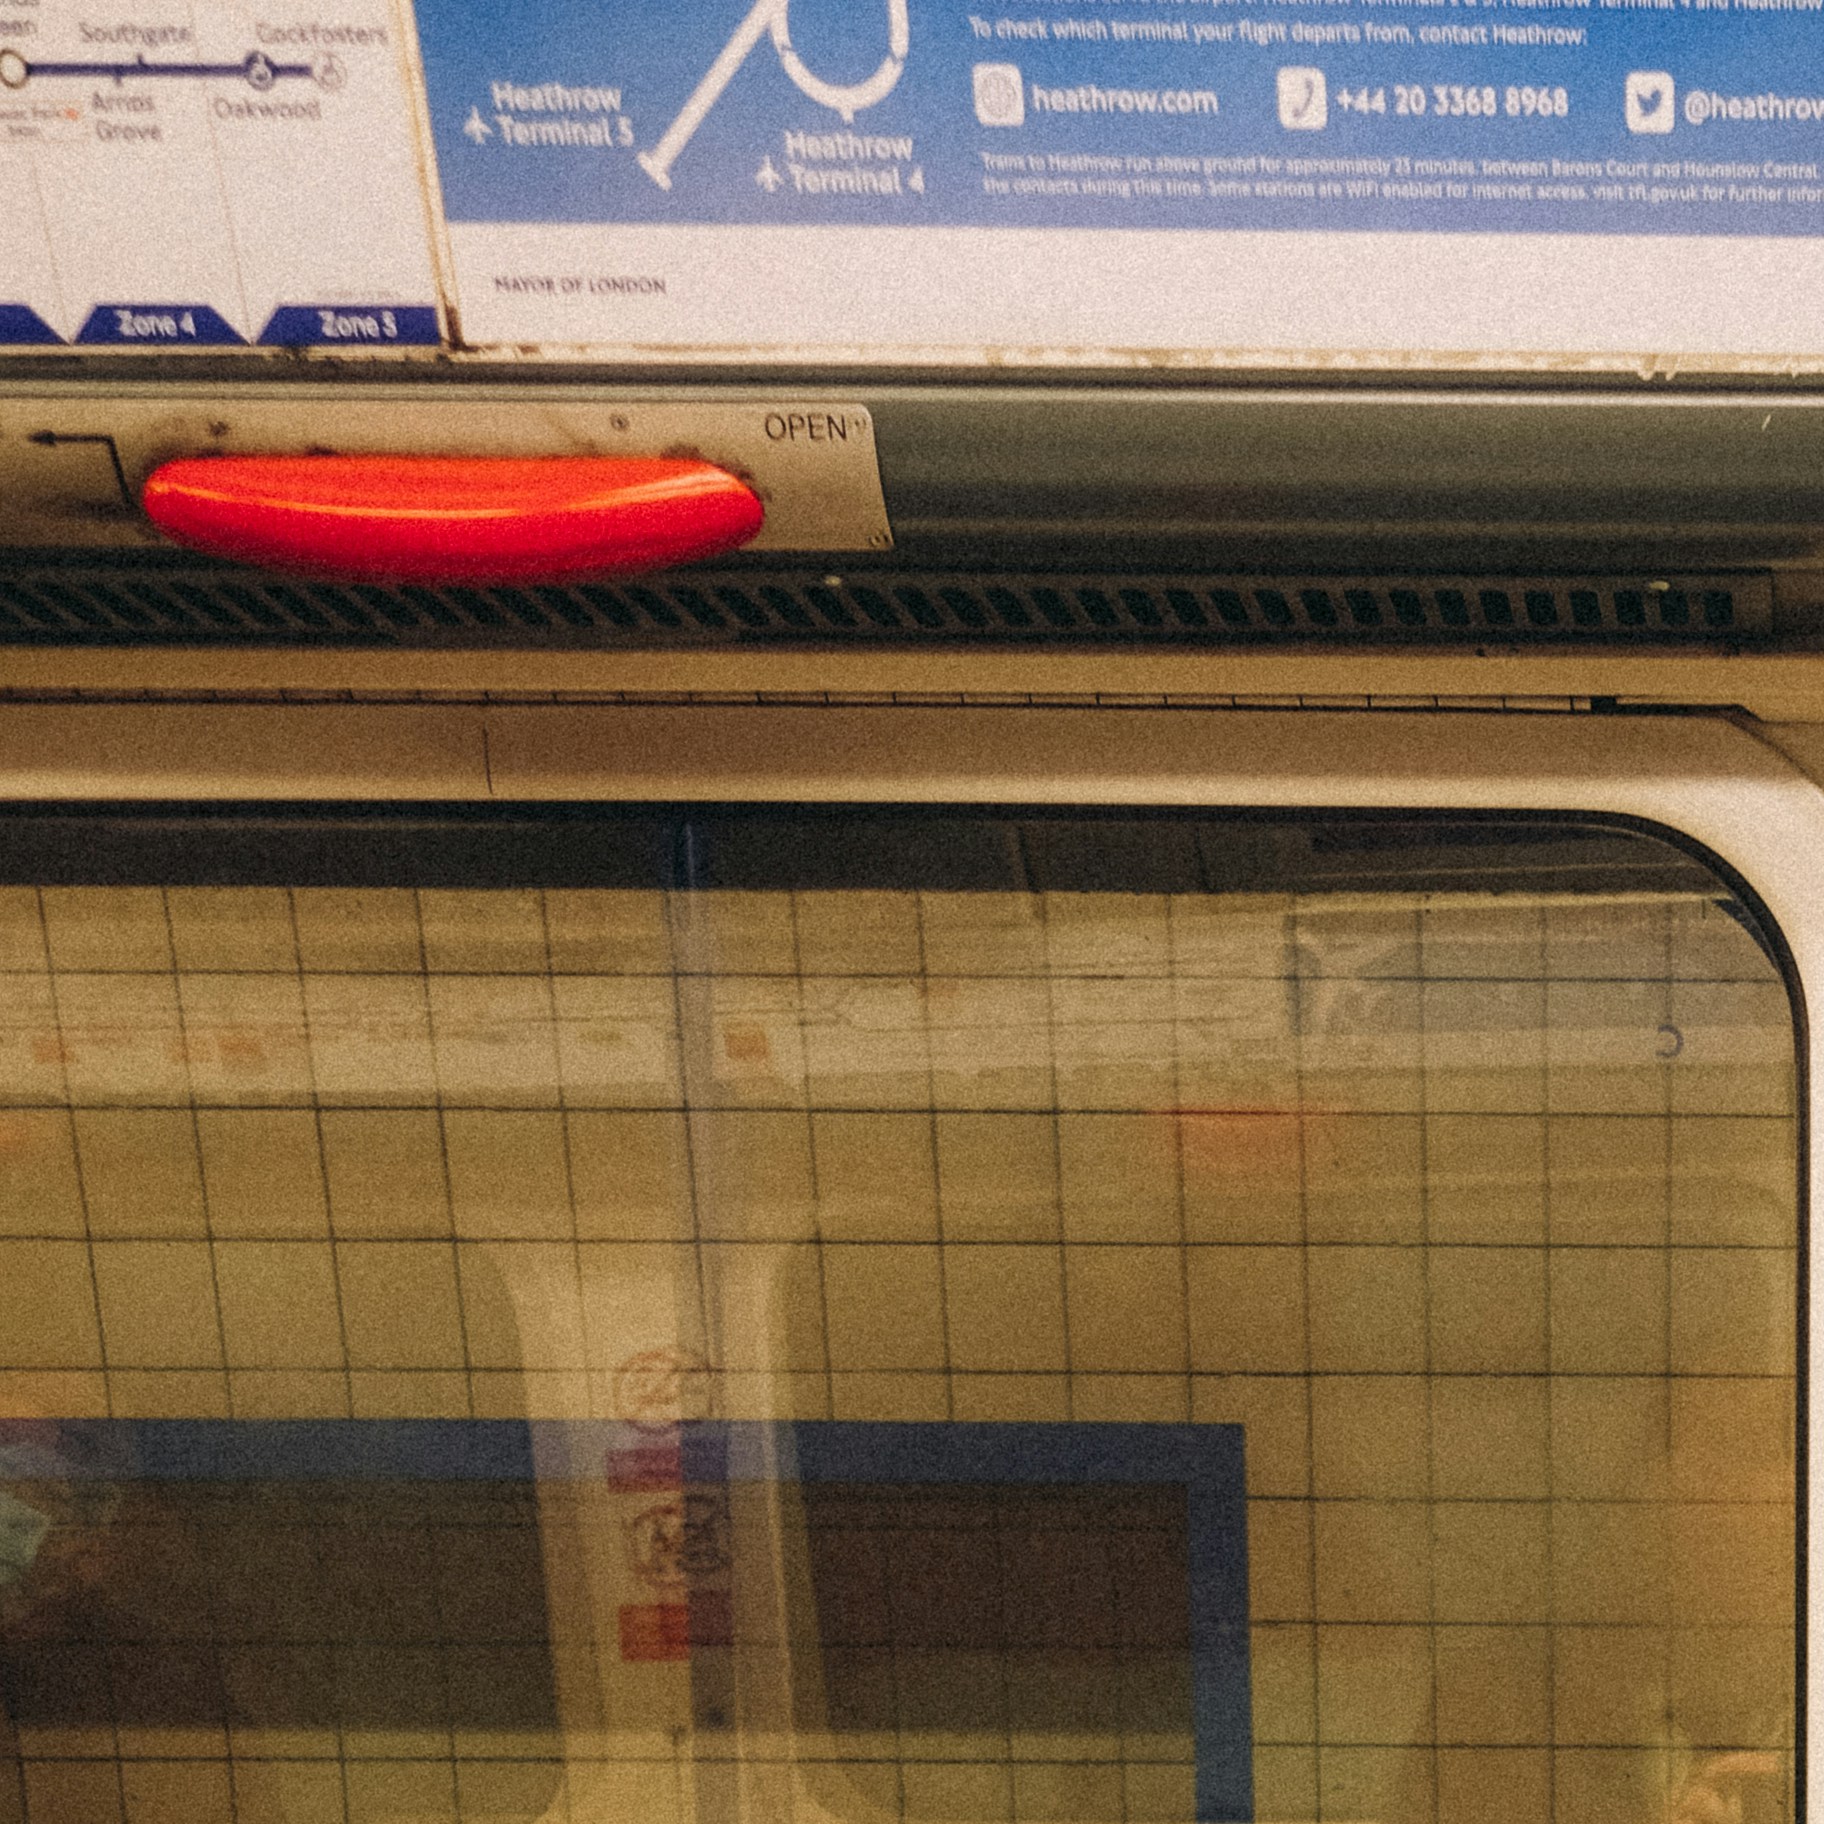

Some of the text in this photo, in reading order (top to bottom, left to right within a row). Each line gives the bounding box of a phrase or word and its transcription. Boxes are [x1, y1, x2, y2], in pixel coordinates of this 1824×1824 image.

[969, 16, 991, 37] To
[995, 18, 1047, 38] check
[1052, 19, 1107, 39] which
[1110, 20, 1189, 41] terminal
[1192, 23, 1234, 44] your
[1237, 18, 1287, 45] flight
[1291, 21, 1361, 46] departs
[1364, 22, 1414, 43] from,
[1419, 25, 1487, 44] contact
[493, 81, 620, 114] Heathrow
[1033, 84, 1218, 115] heathrow.com
[1337, 85, 1568, 116] +44 20 3368 8968
[496, 115, 634, 146] Terminal 5
[785, 131, 912, 162] Heathrow
[786, 160, 924, 195] Terminal 4
[561, 278, 582, 293] OF
[589, 275, 665, 295] LONDON
[764, 413, 848, 443] OPEN
